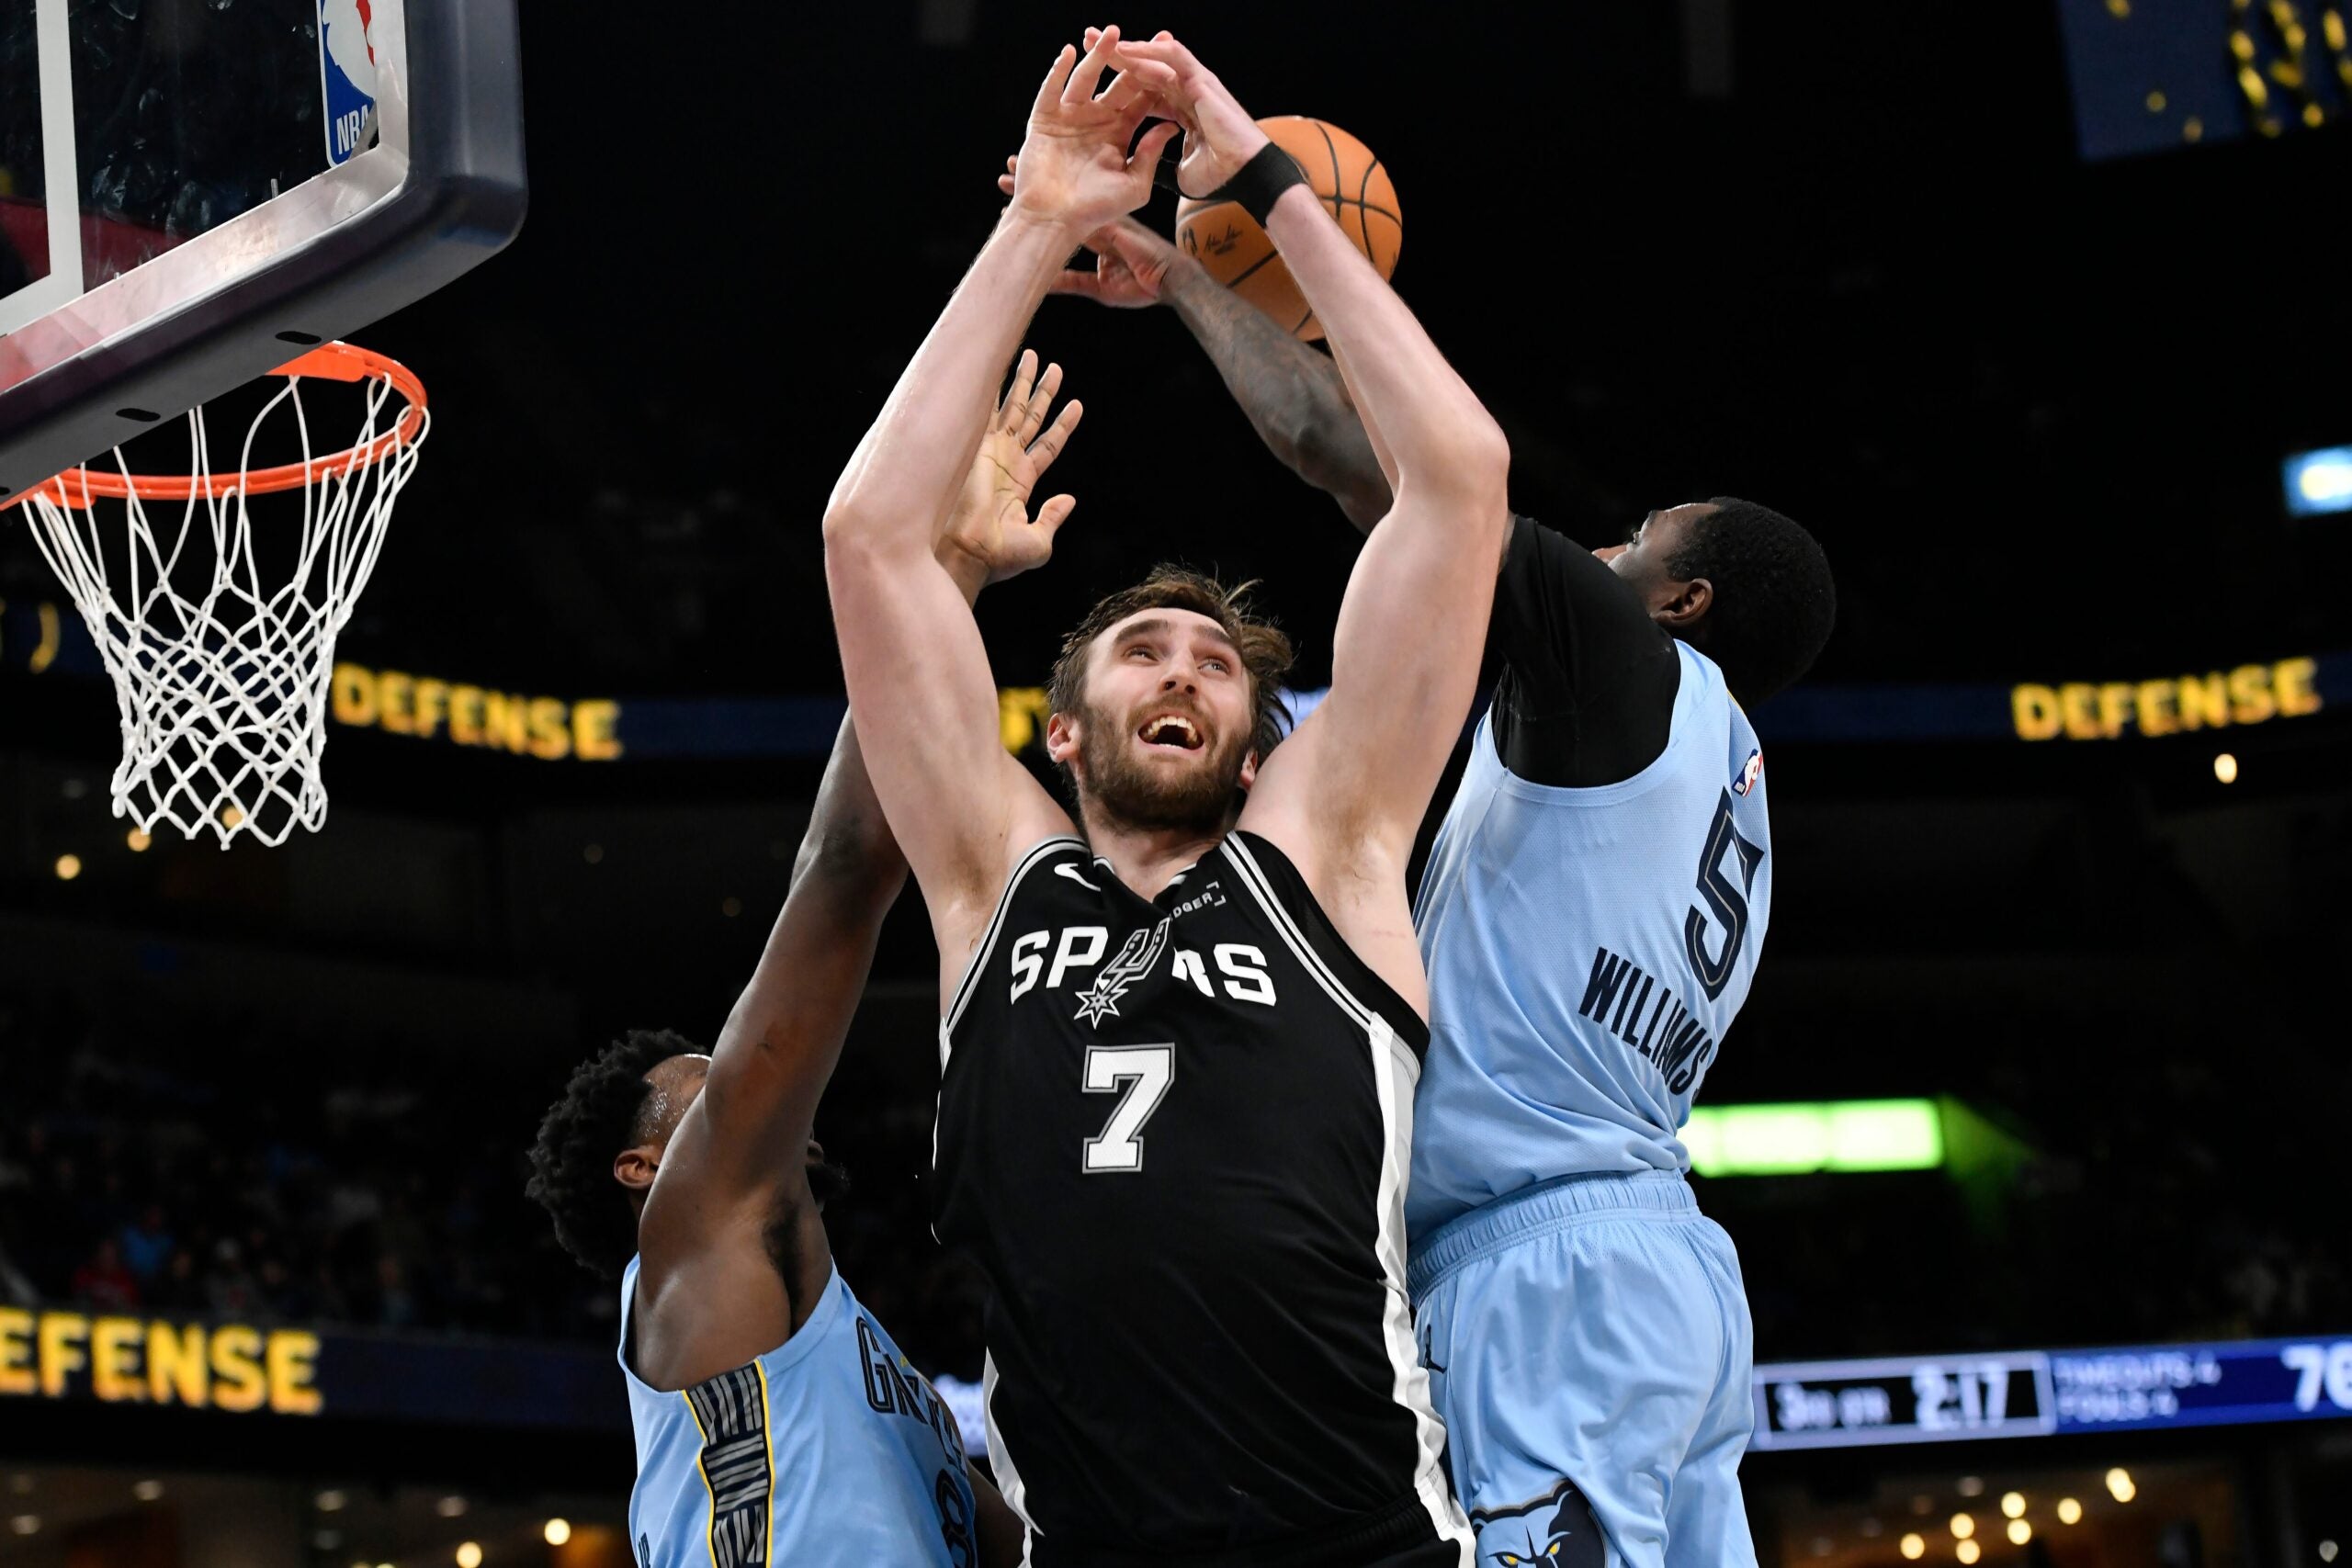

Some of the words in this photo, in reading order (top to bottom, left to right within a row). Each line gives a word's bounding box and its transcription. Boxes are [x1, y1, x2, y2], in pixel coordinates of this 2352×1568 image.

[332, 662, 622, 761] DEFENSE
[2011, 657, 2323, 741] DEFENSE
[1170, 892, 1213, 921] DGER
[1685, 785, 1765, 1002] 5
[1578, 946, 1713, 1096] WILLIAMS
[1082, 1043, 1175, 1174] 7
[1912, 1363, 2009, 1431] 2:17
